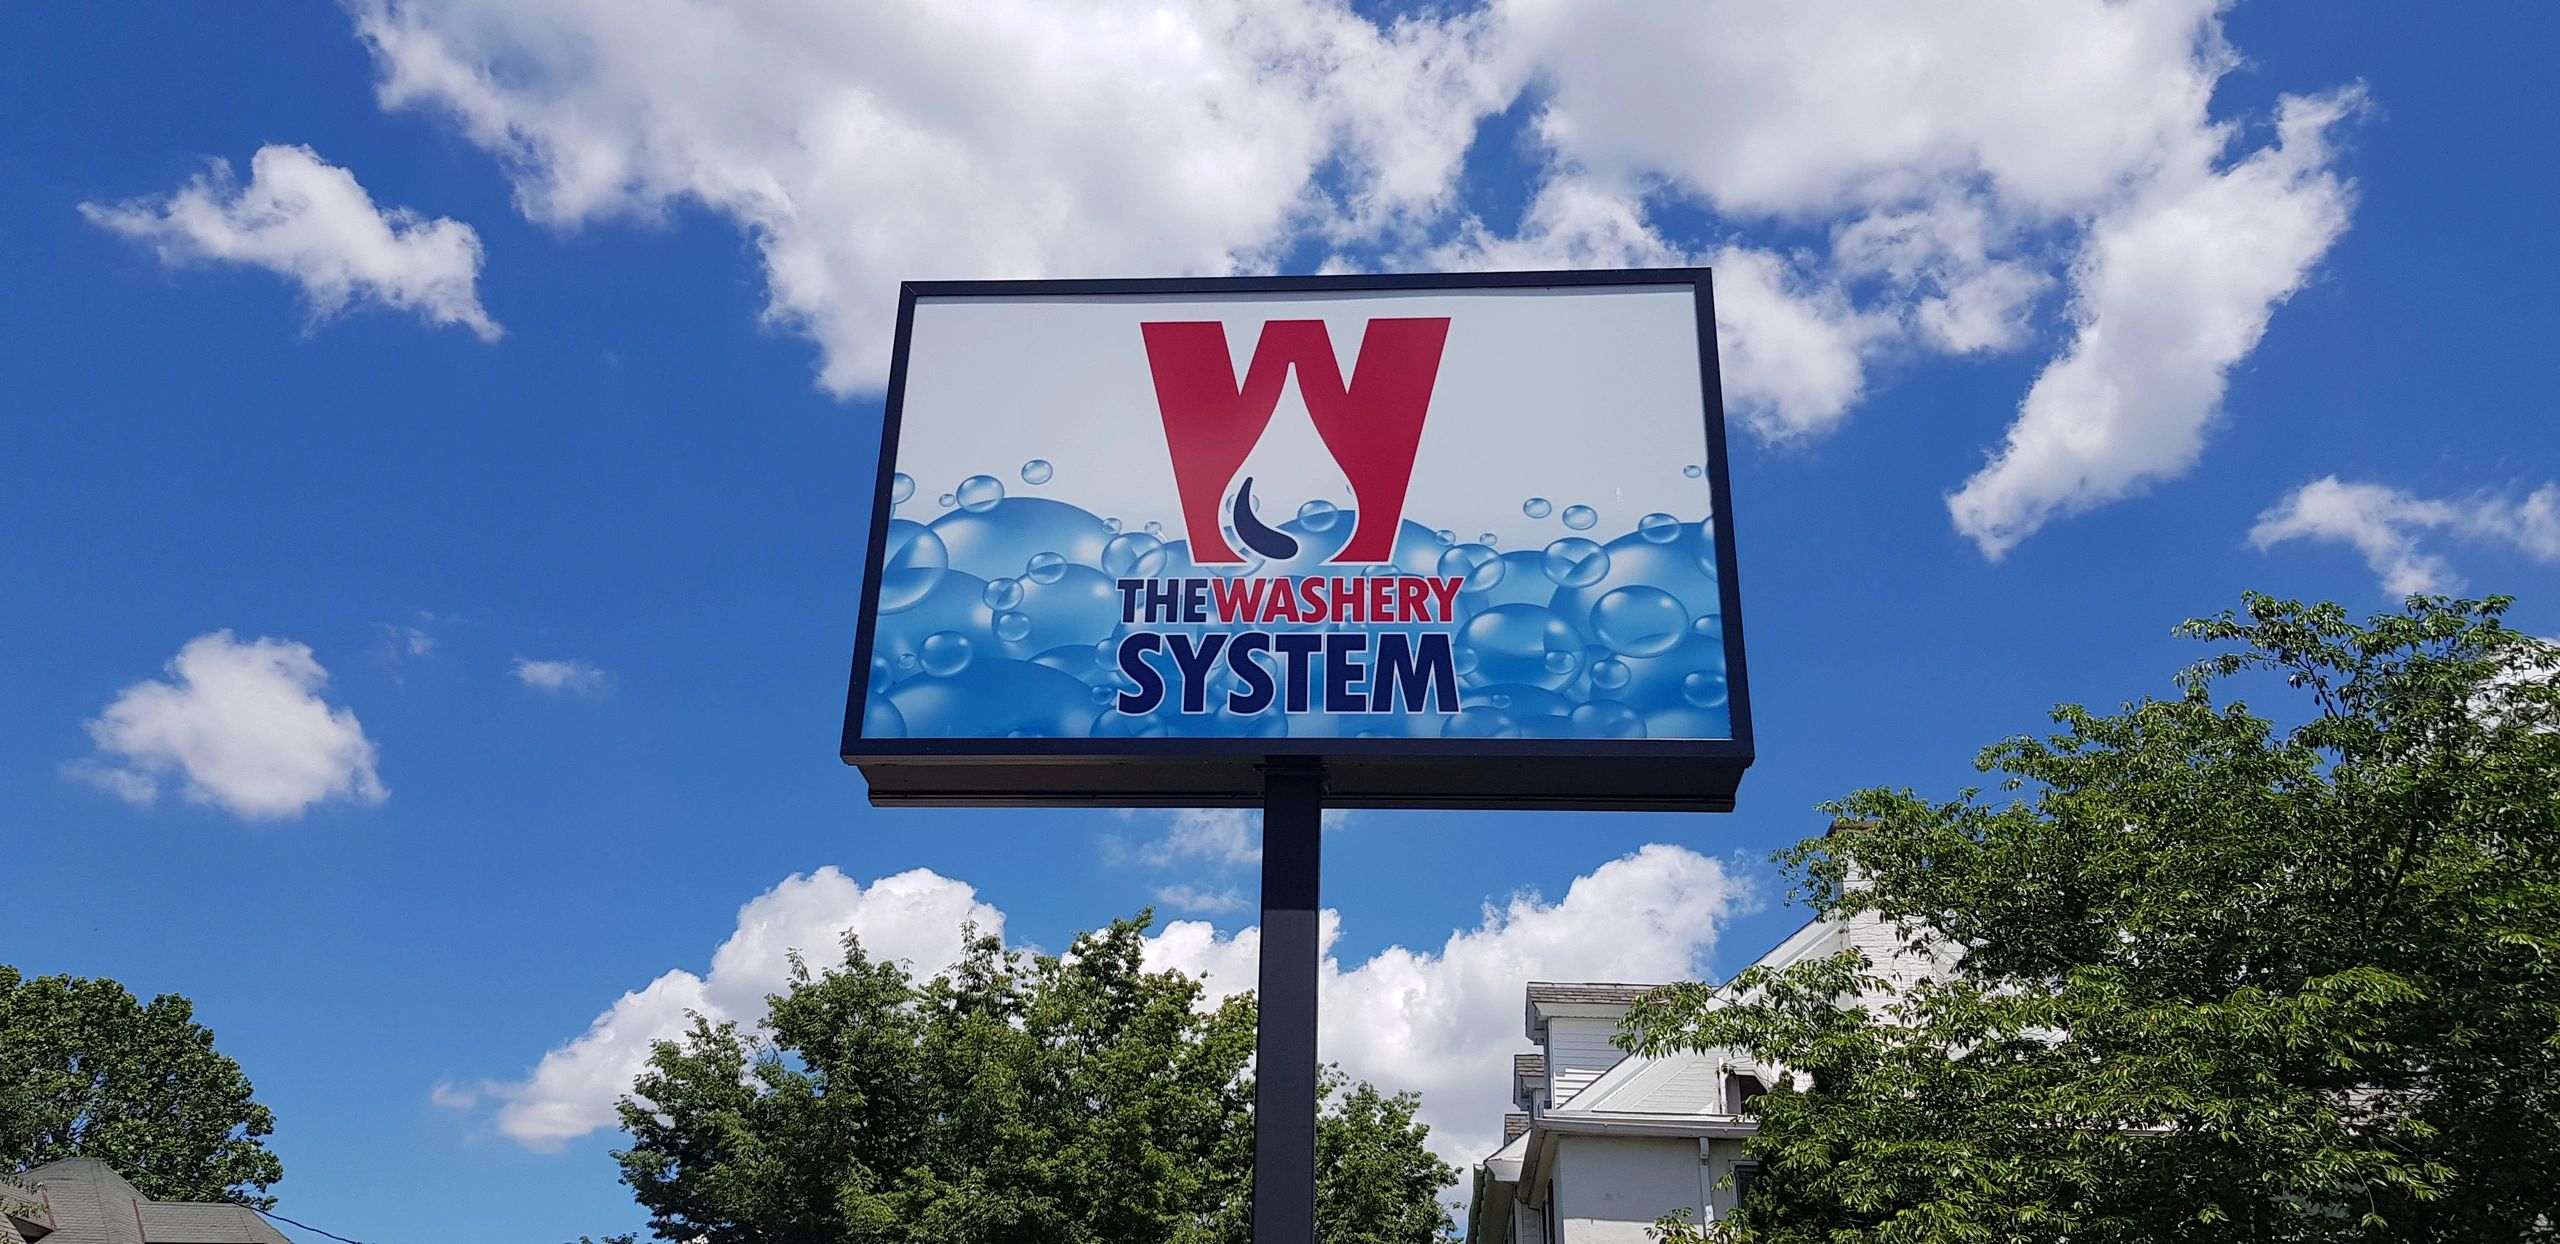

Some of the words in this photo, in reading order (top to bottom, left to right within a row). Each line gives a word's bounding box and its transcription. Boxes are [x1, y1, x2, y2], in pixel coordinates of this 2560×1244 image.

[1140, 317, 1452, 563] W
[1117, 578, 1208, 623] THE
[1211, 577, 1464, 623] WASHERY
[1116, 632, 1462, 714] SYSTEM
